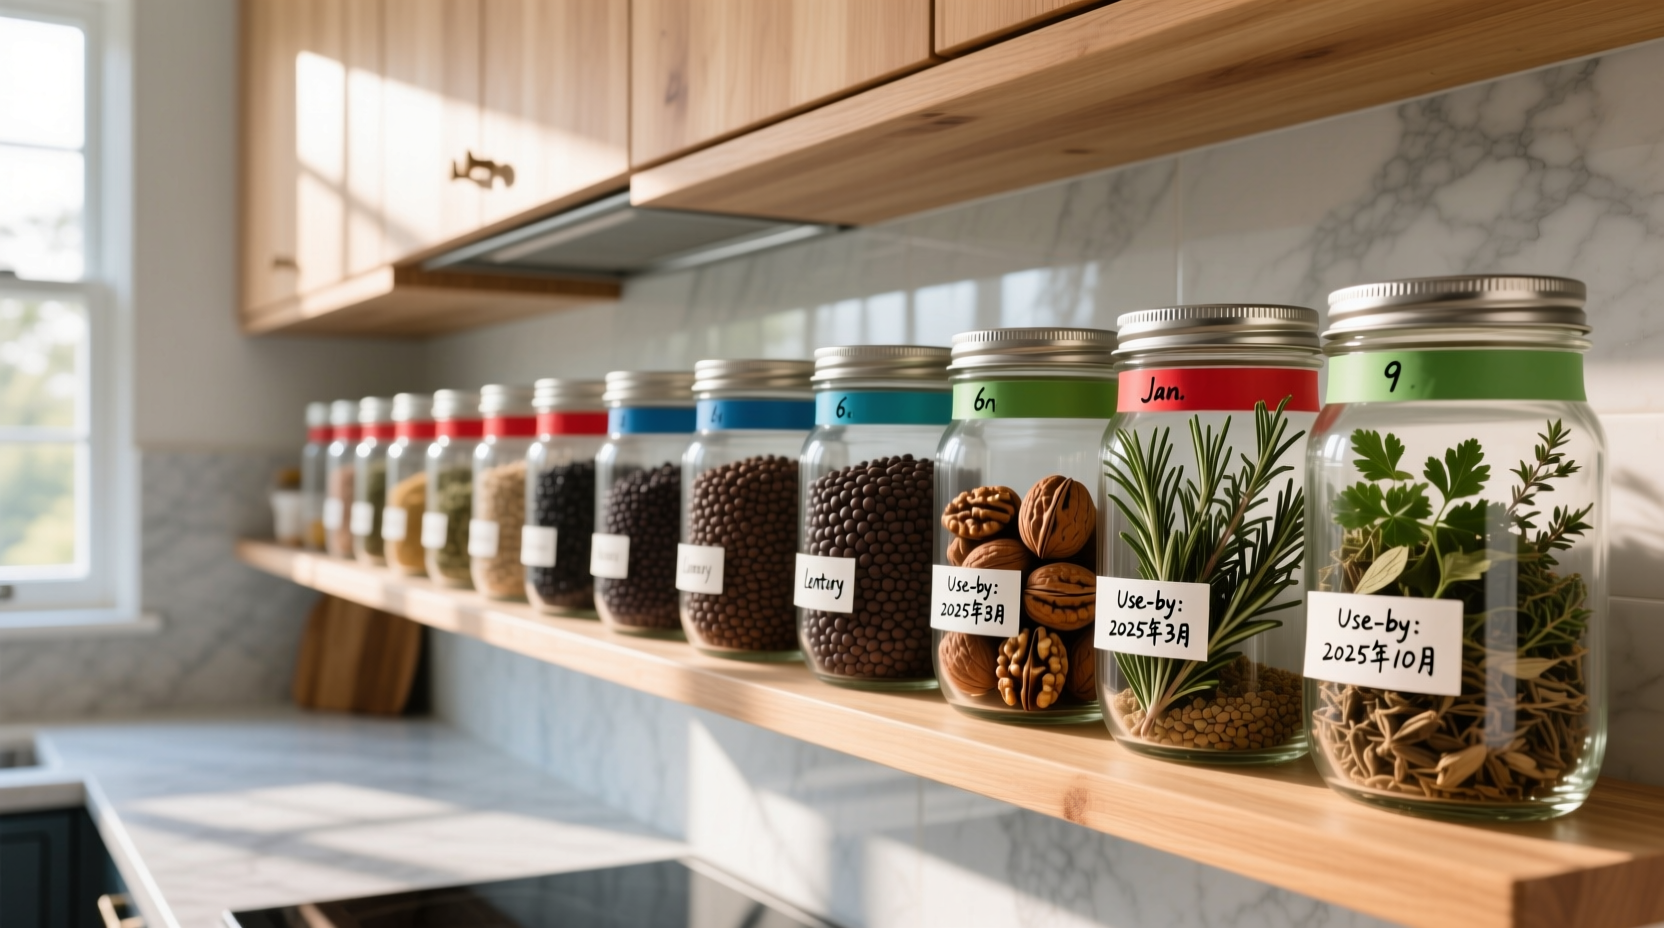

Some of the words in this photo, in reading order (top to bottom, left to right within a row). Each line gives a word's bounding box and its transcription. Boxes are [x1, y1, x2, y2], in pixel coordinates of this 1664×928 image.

[1140, 376, 1185, 403] Jan.
[948, 575, 998, 601] Use-by:
[940, 599, 1005, 625] 2025年3月
[1117, 589, 1183, 620] Use-by:
[1109, 617, 1190, 648] 2025年3月
[1338, 607, 1420, 643] Use-by:
[1322, 639, 1434, 676] 2025年10月
